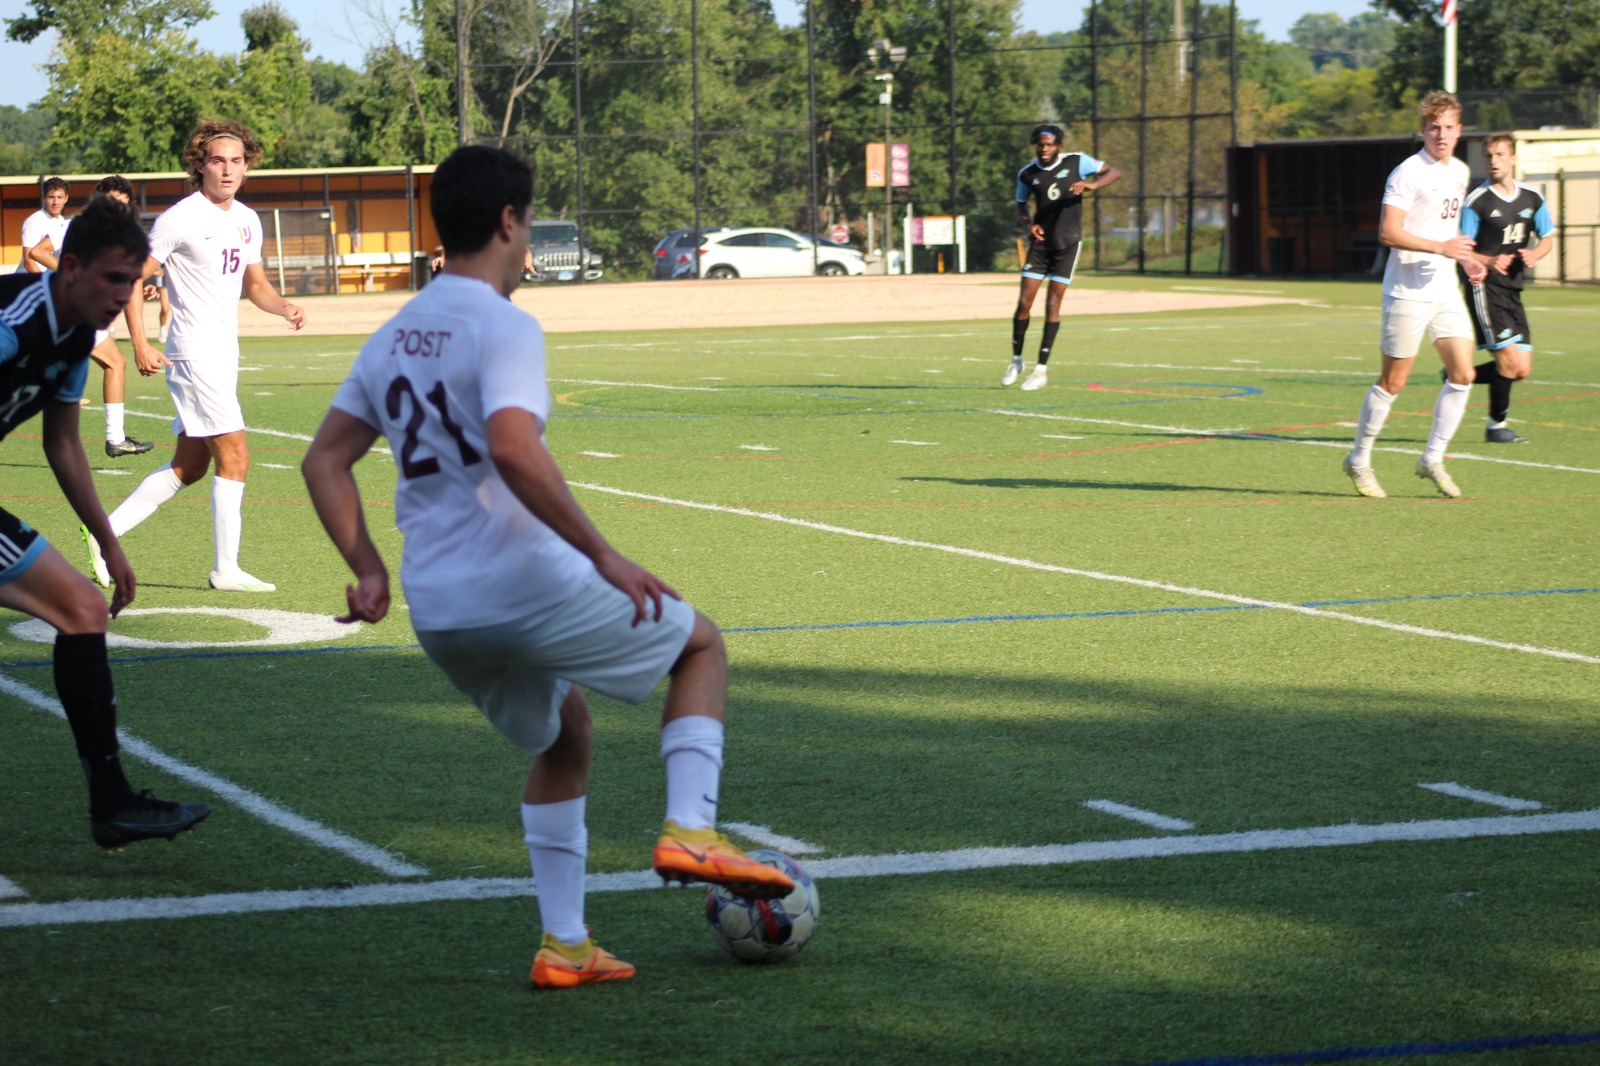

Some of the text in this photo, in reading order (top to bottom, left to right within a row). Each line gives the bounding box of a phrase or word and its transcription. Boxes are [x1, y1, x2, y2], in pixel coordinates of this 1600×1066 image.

[1047, 183, 1061, 200] 6
[1441, 198, 1459, 219] 39
[1502, 222, 1526, 244] 14
[222, 248, 240, 275] 15
[390, 330, 452, 358] POST
[386, 375, 482, 480] 21
